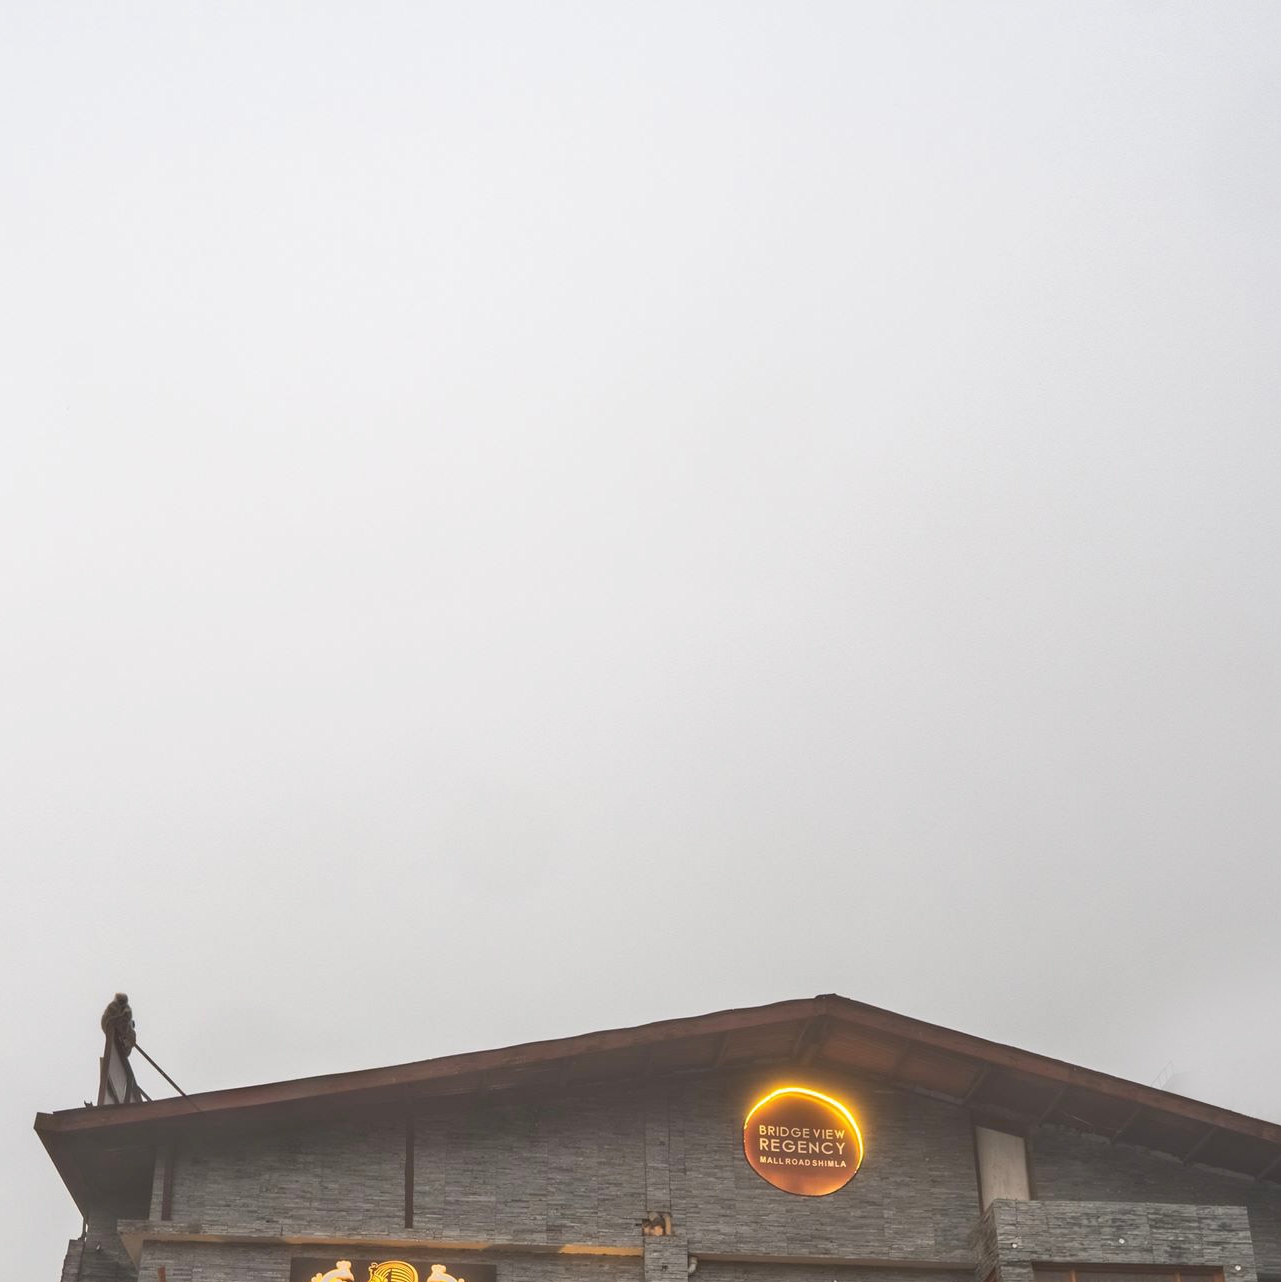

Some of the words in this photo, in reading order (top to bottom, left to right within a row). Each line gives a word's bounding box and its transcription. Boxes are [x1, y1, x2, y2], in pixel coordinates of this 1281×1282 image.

[759, 1125, 810, 1139] BRIDGE
[813, 1129, 845, 1140] VIEW
[759, 1138, 845, 1155] REGENCY
[760, 1156, 784, 1165] MALL
[785, 1158, 811, 1166] ROAD
[812, 1159, 847, 1168] SHIMLA
